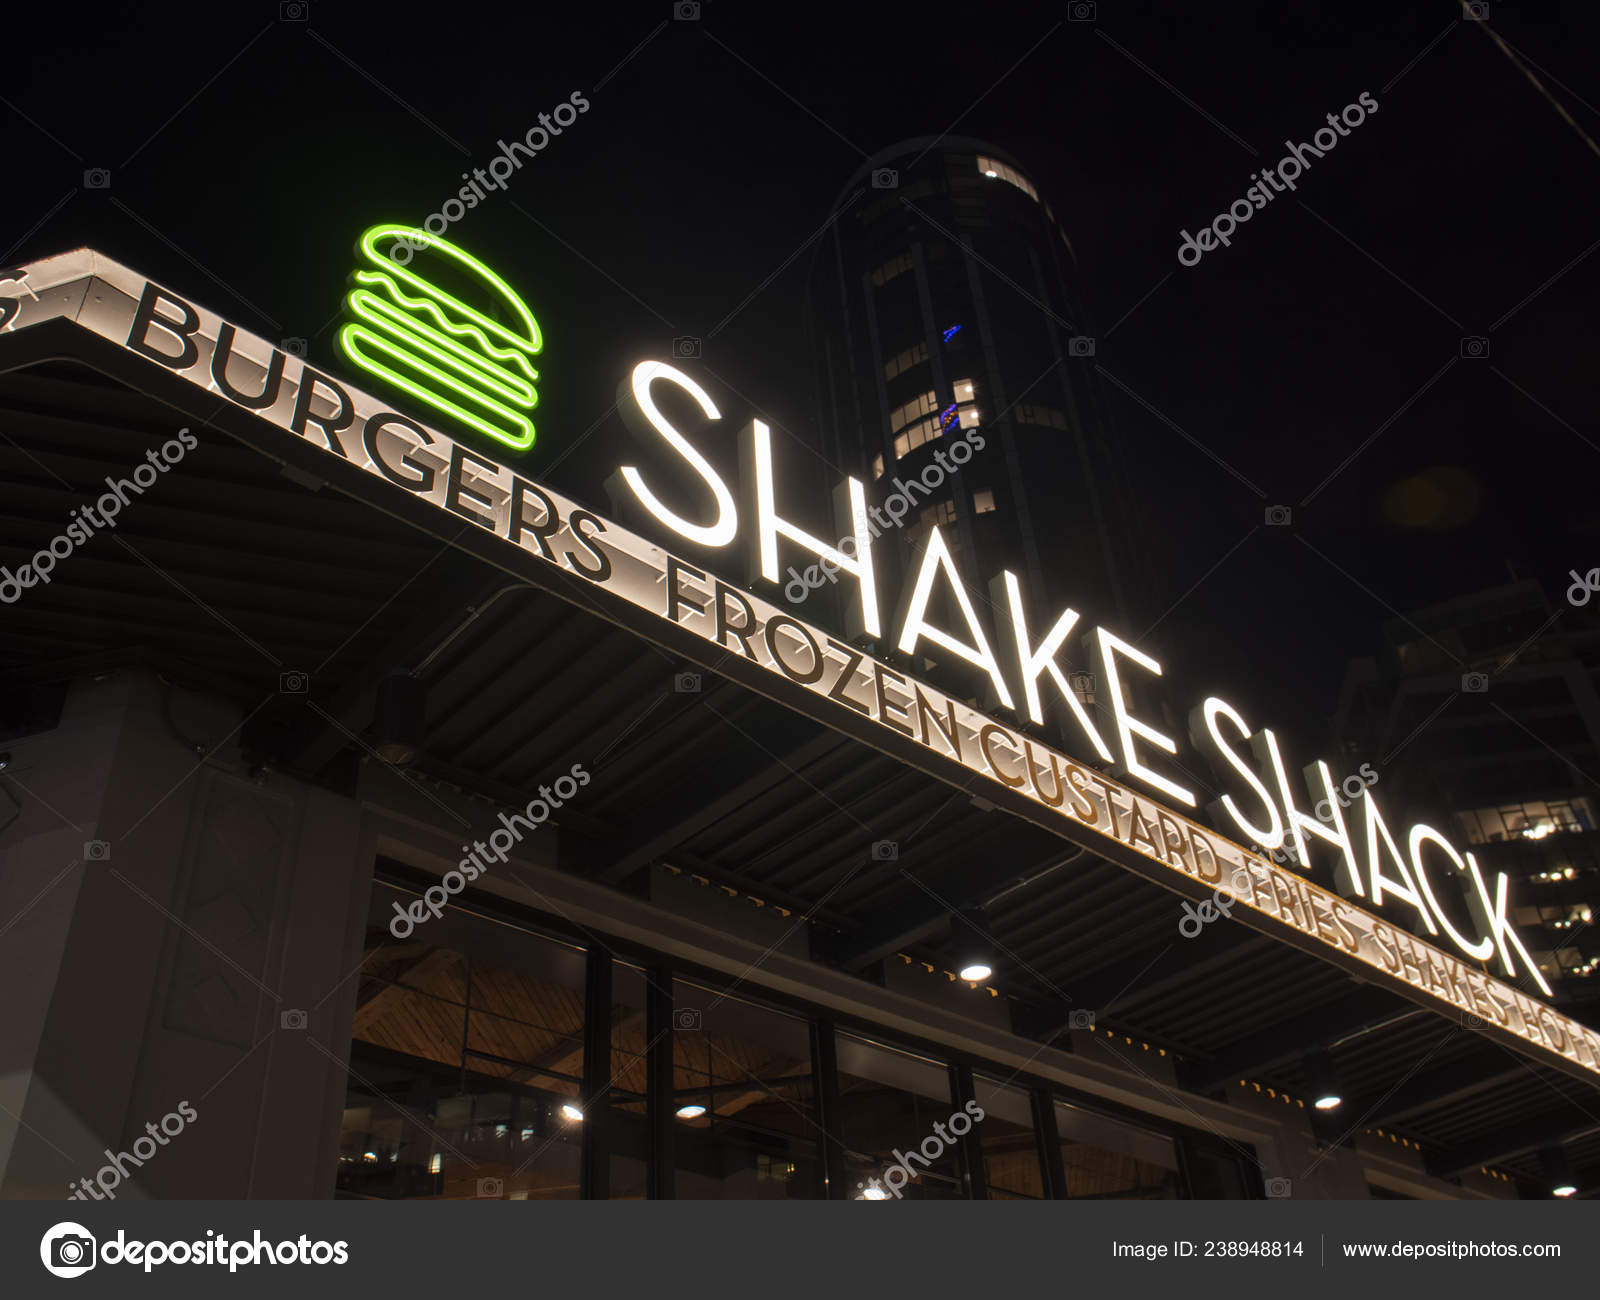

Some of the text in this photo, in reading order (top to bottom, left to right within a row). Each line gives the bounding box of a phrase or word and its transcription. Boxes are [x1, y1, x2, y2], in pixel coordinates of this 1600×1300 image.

[126, 281, 611, 583] BURGERS
[666, 555, 962, 763] FROZEN
[980, 723, 1222, 884] CUSTARD
[1243, 855, 1358, 954] FRIES
[1373, 923, 1508, 1026] SHAKES
[1513, 991, 1581, 1062] HOT
[618, 359, 1553, 996] SHAKE SHACK
